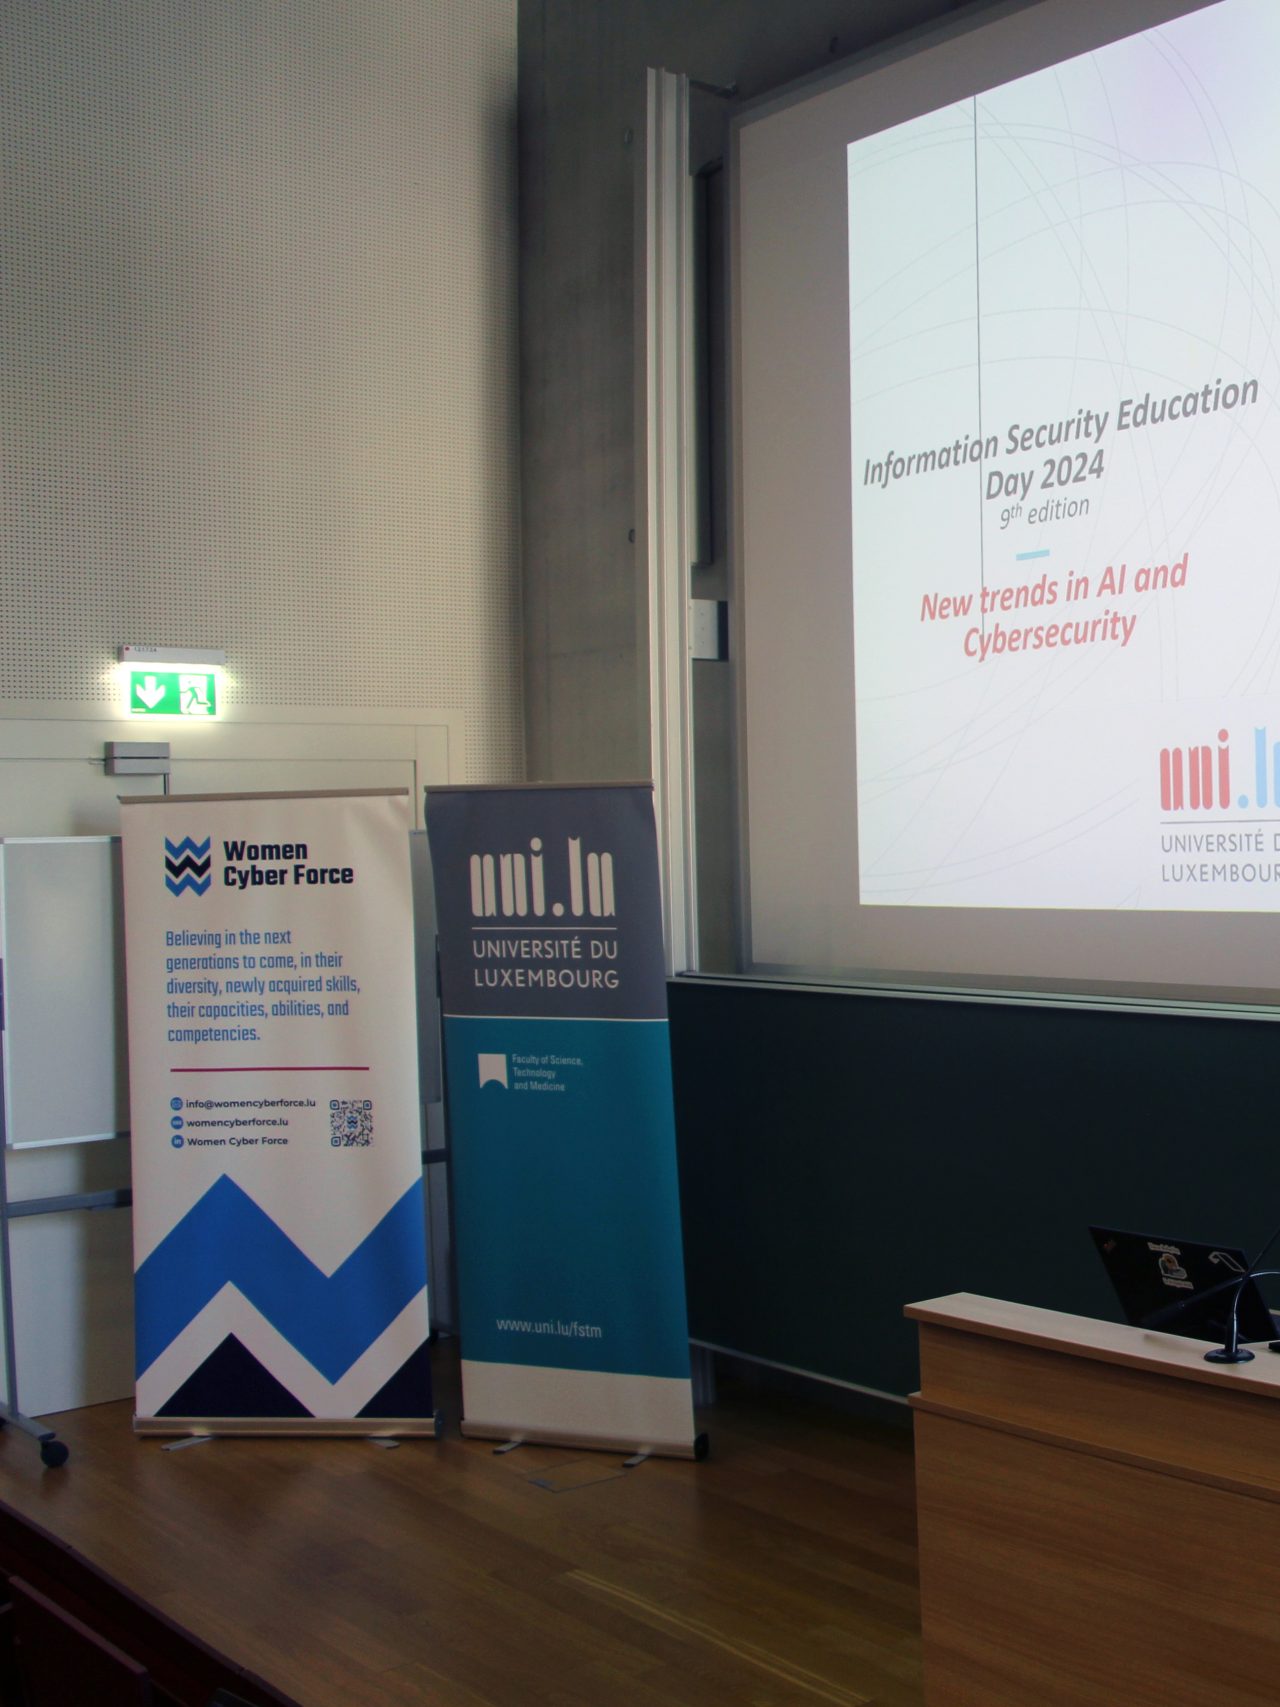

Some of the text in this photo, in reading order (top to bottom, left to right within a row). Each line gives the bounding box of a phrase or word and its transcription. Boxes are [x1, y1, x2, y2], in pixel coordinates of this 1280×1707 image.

[863, 378, 1259, 488] Information Security Education
[986, 449, 1105, 501] Day 2024
[1000, 496, 1089, 530] 9th edition
[920, 552, 1189, 622] New trends in AI and
[964, 609, 1136, 663] Cybersecurity
[224, 840, 308, 861] Women
[1161, 829, 1265, 853] UNIVERSITÉ
[224, 864, 354, 889] Cyber Force
[470, 836, 616, 917] uni.lu
[166, 929, 292, 949] Believing in the next
[473, 937, 618, 959] UNIVERSITÉ DU
[166, 952, 343, 972] generations to come, in their
[167, 976, 360, 996] diversity, newly acquired skills,
[475, 969, 619, 988] LUXEMBOURG
[167, 1000, 349, 1021] their capacities, abilities, and
[168, 1026, 260, 1044] competencies.
[512, 1054, 539, 1065] Faculty
[541, 1054, 548, 1064] of
[513, 1067, 555, 1079] Technology
[514, 1081, 565, 1091] and Medicine
[186, 1098, 316, 1110] info@womencyberforce.lu
[187, 1117, 288, 1129] womencyberforce.lu
[188, 1136, 288, 1148] Women Cyber Force
[496, 1318, 602, 1338] www.uni.lu/fstm
